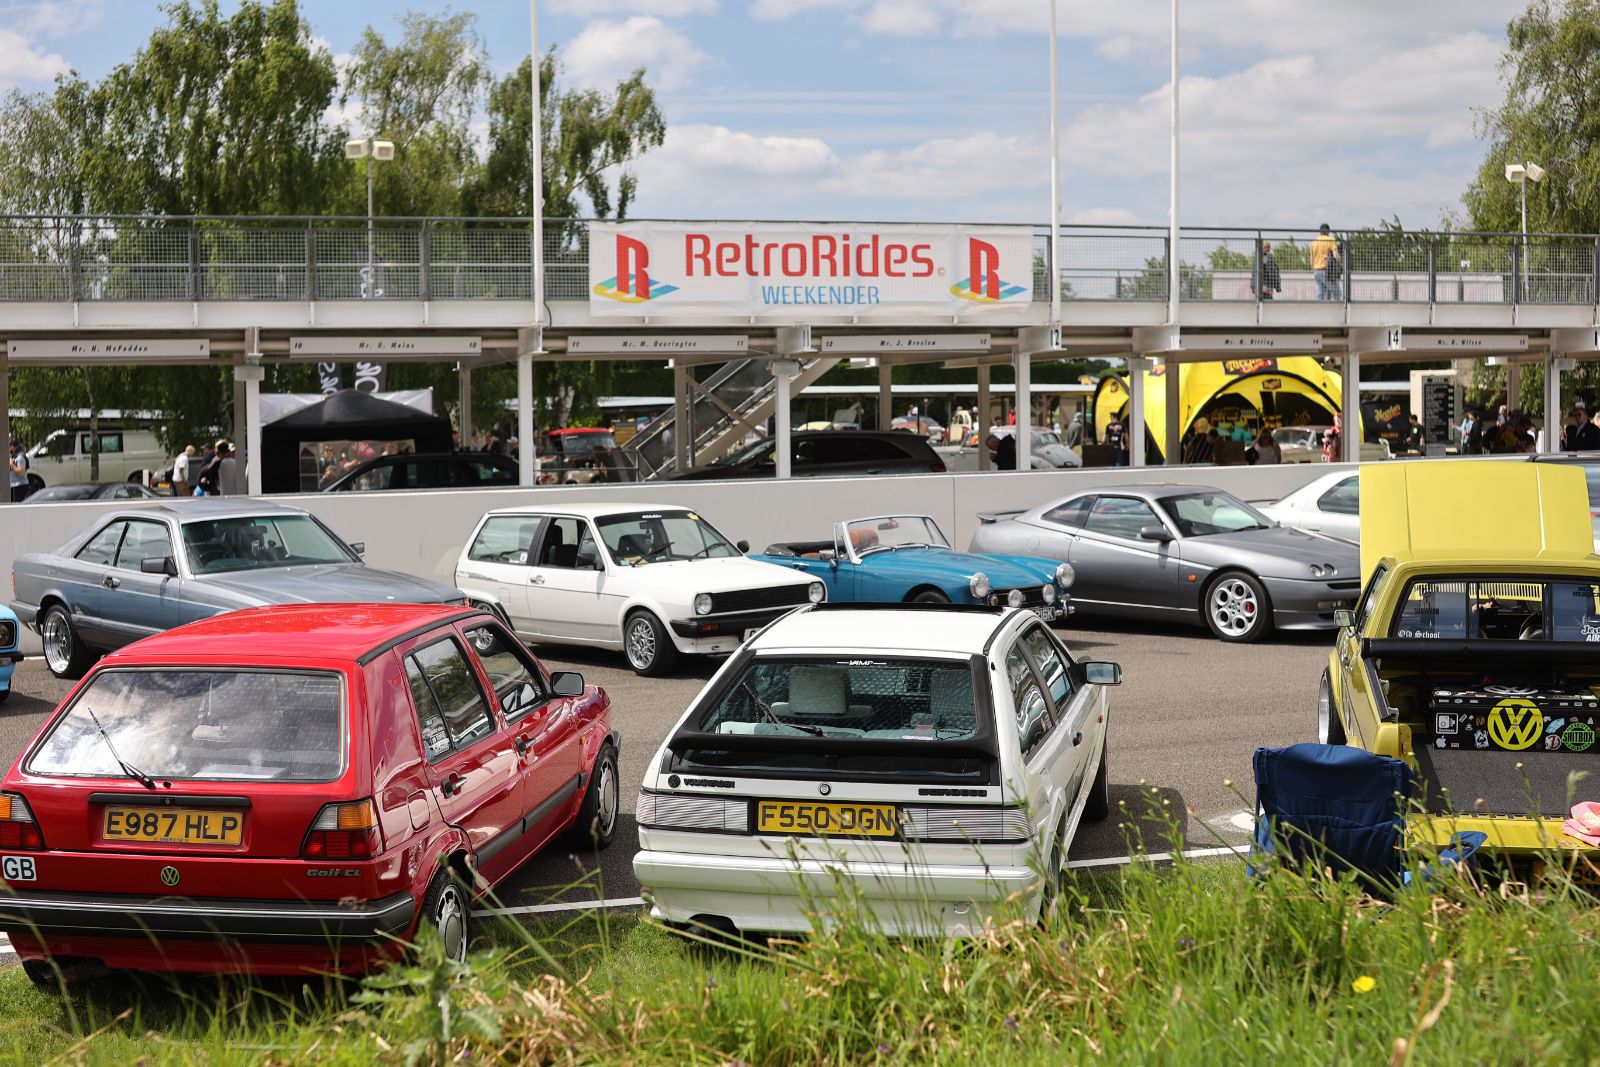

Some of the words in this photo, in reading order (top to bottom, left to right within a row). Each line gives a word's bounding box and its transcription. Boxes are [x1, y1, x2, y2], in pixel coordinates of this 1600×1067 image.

[685, 233, 934, 277] RetroRides
[761, 286, 880, 304] WEEKENDER
[1050, 329, 1059, 346] 12
[1388, 330, 1399, 346] 14
[1563, 731, 1594, 744] SHITBOX
[106, 811, 178, 837] E987
[184, 814, 238, 840] HLP
[761, 804, 830, 829] F550
[840, 807, 892, 831] DGN
[4, 857, 35, 879] GB
